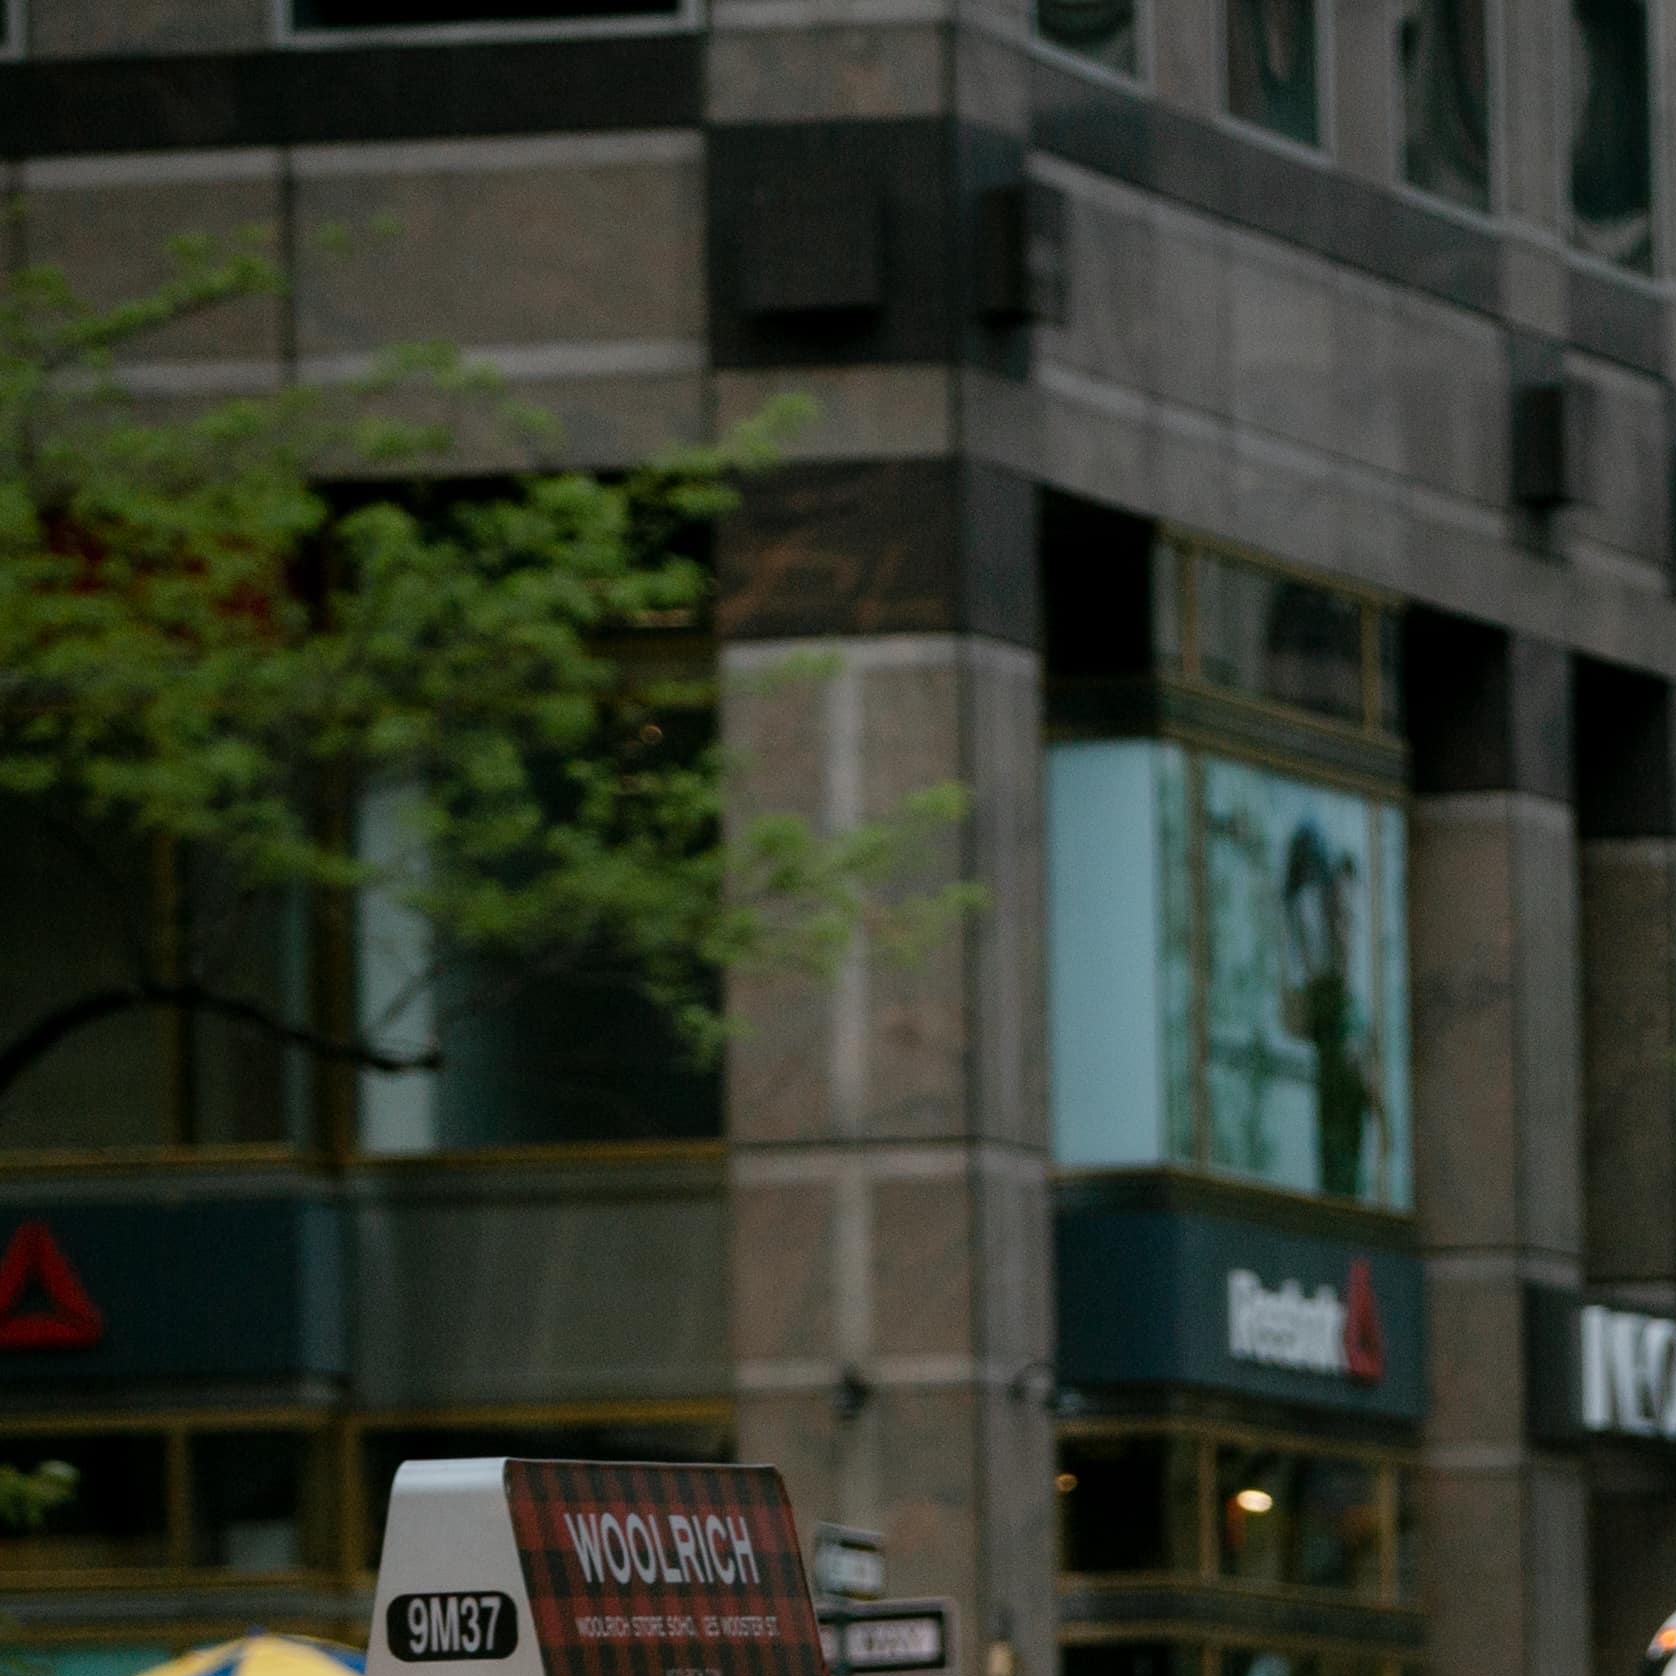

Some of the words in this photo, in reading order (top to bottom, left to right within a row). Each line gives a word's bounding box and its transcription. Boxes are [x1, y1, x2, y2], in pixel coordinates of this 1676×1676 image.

[564, 1512, 760, 1584] WOOLRICH
[407, 1596, 500, 1655] 9M37
[575, 1615, 630, 1638] WOOLRICH
